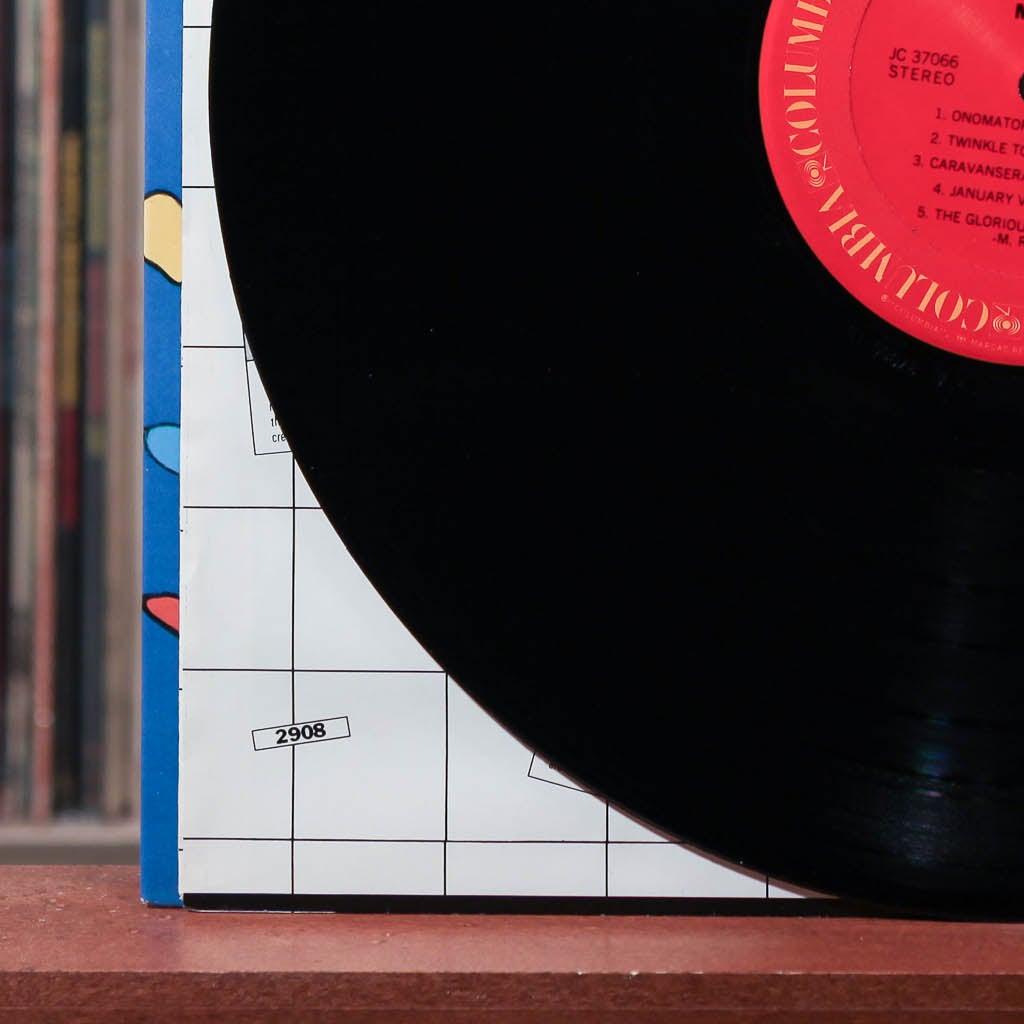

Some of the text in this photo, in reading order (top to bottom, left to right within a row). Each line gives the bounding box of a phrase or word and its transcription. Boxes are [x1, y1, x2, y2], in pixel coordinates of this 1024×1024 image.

[889, 48, 960, 69] JC 37066
[888, 64, 956, 86] STEREO
[936, 107, 946, 120] 1.
[930, 132, 941, 145] 2.
[948, 135, 1008, 155] TWINKLE
[933, 183, 944, 195] 4.
[949, 185, 1014, 205] JANUARY
[917, 205, 928, 218] 5.
[935, 208, 961, 224] THE
[819, 184, 989, 331] COLUMBIA
[275, 722, 326, 744] 2908
